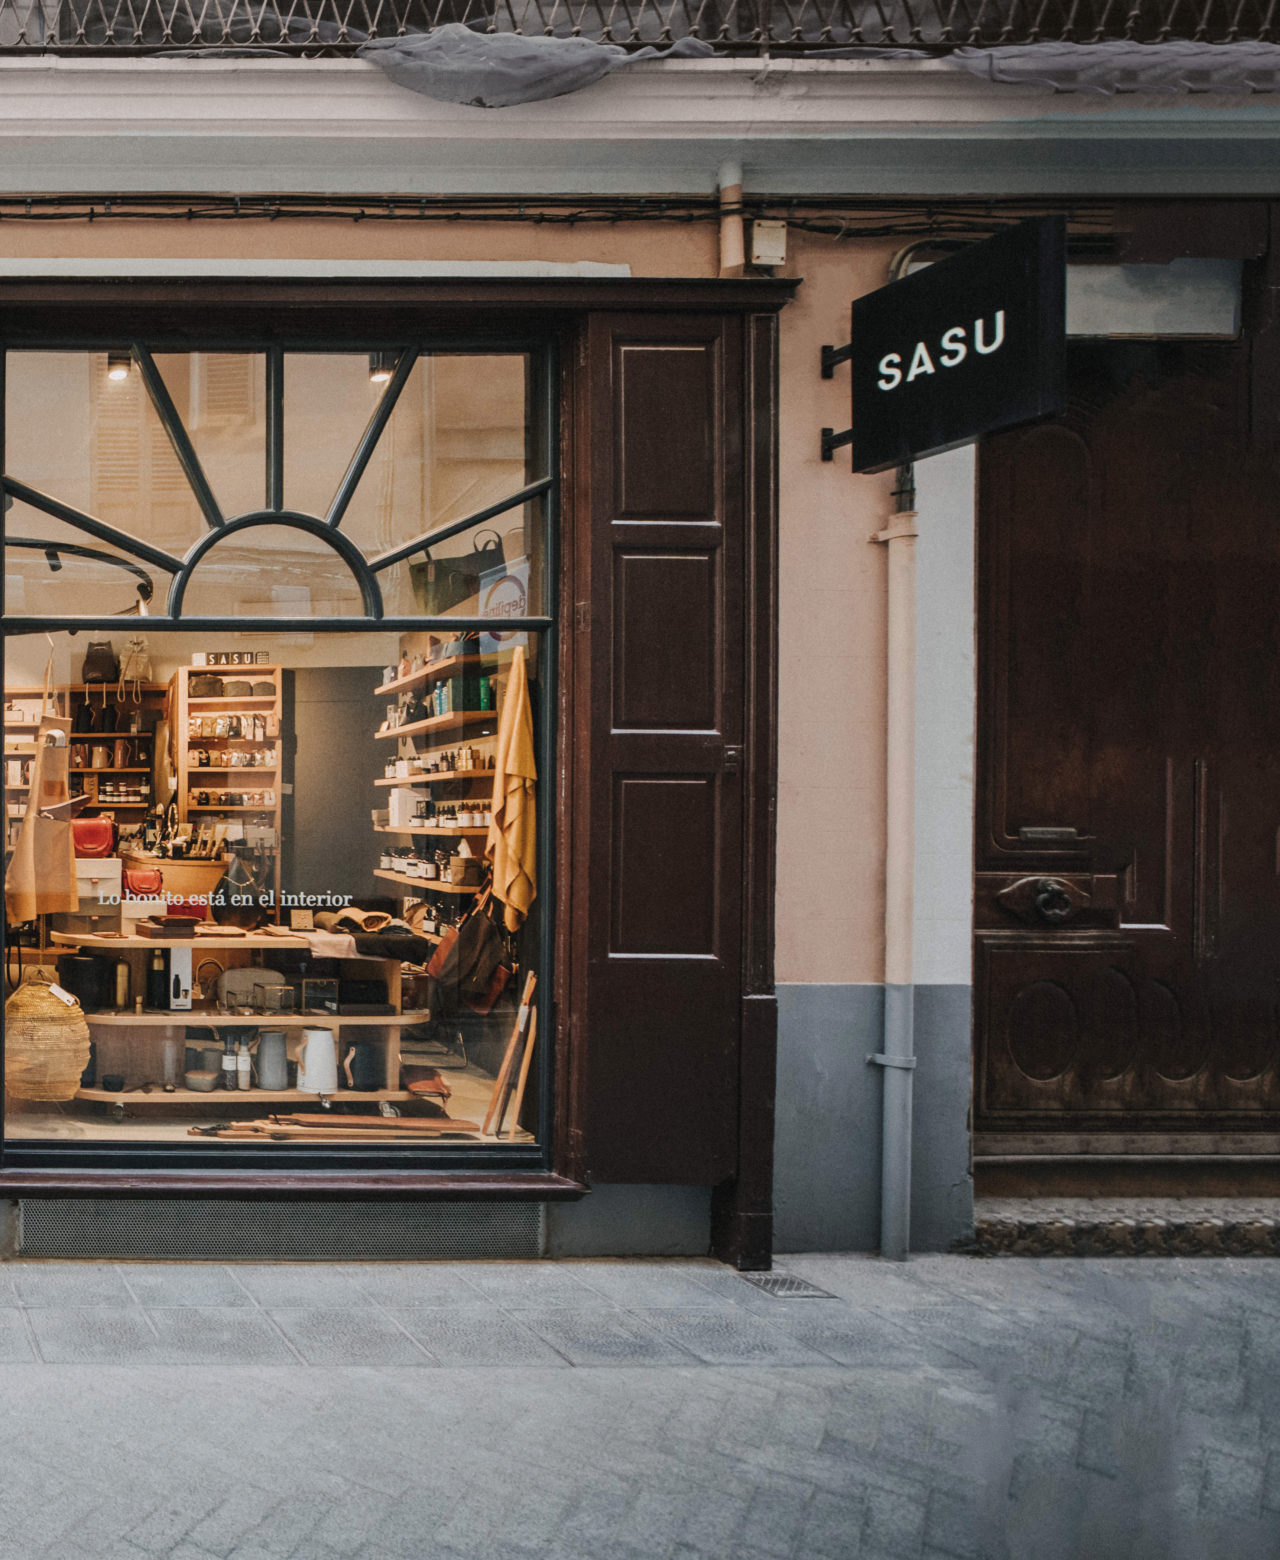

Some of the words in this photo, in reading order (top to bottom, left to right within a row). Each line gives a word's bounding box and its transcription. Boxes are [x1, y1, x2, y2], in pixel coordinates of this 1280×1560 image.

[876, 310, 1006, 391] SASU
[209, 653, 251, 665] SASU
[97, 891, 120, 906] Lo
[125, 890, 184, 906] bonito
[188, 890, 226, 906] está
[230, 894, 254, 906] en
[258, 890, 277, 907] el
[281, 891, 353, 907] interior
